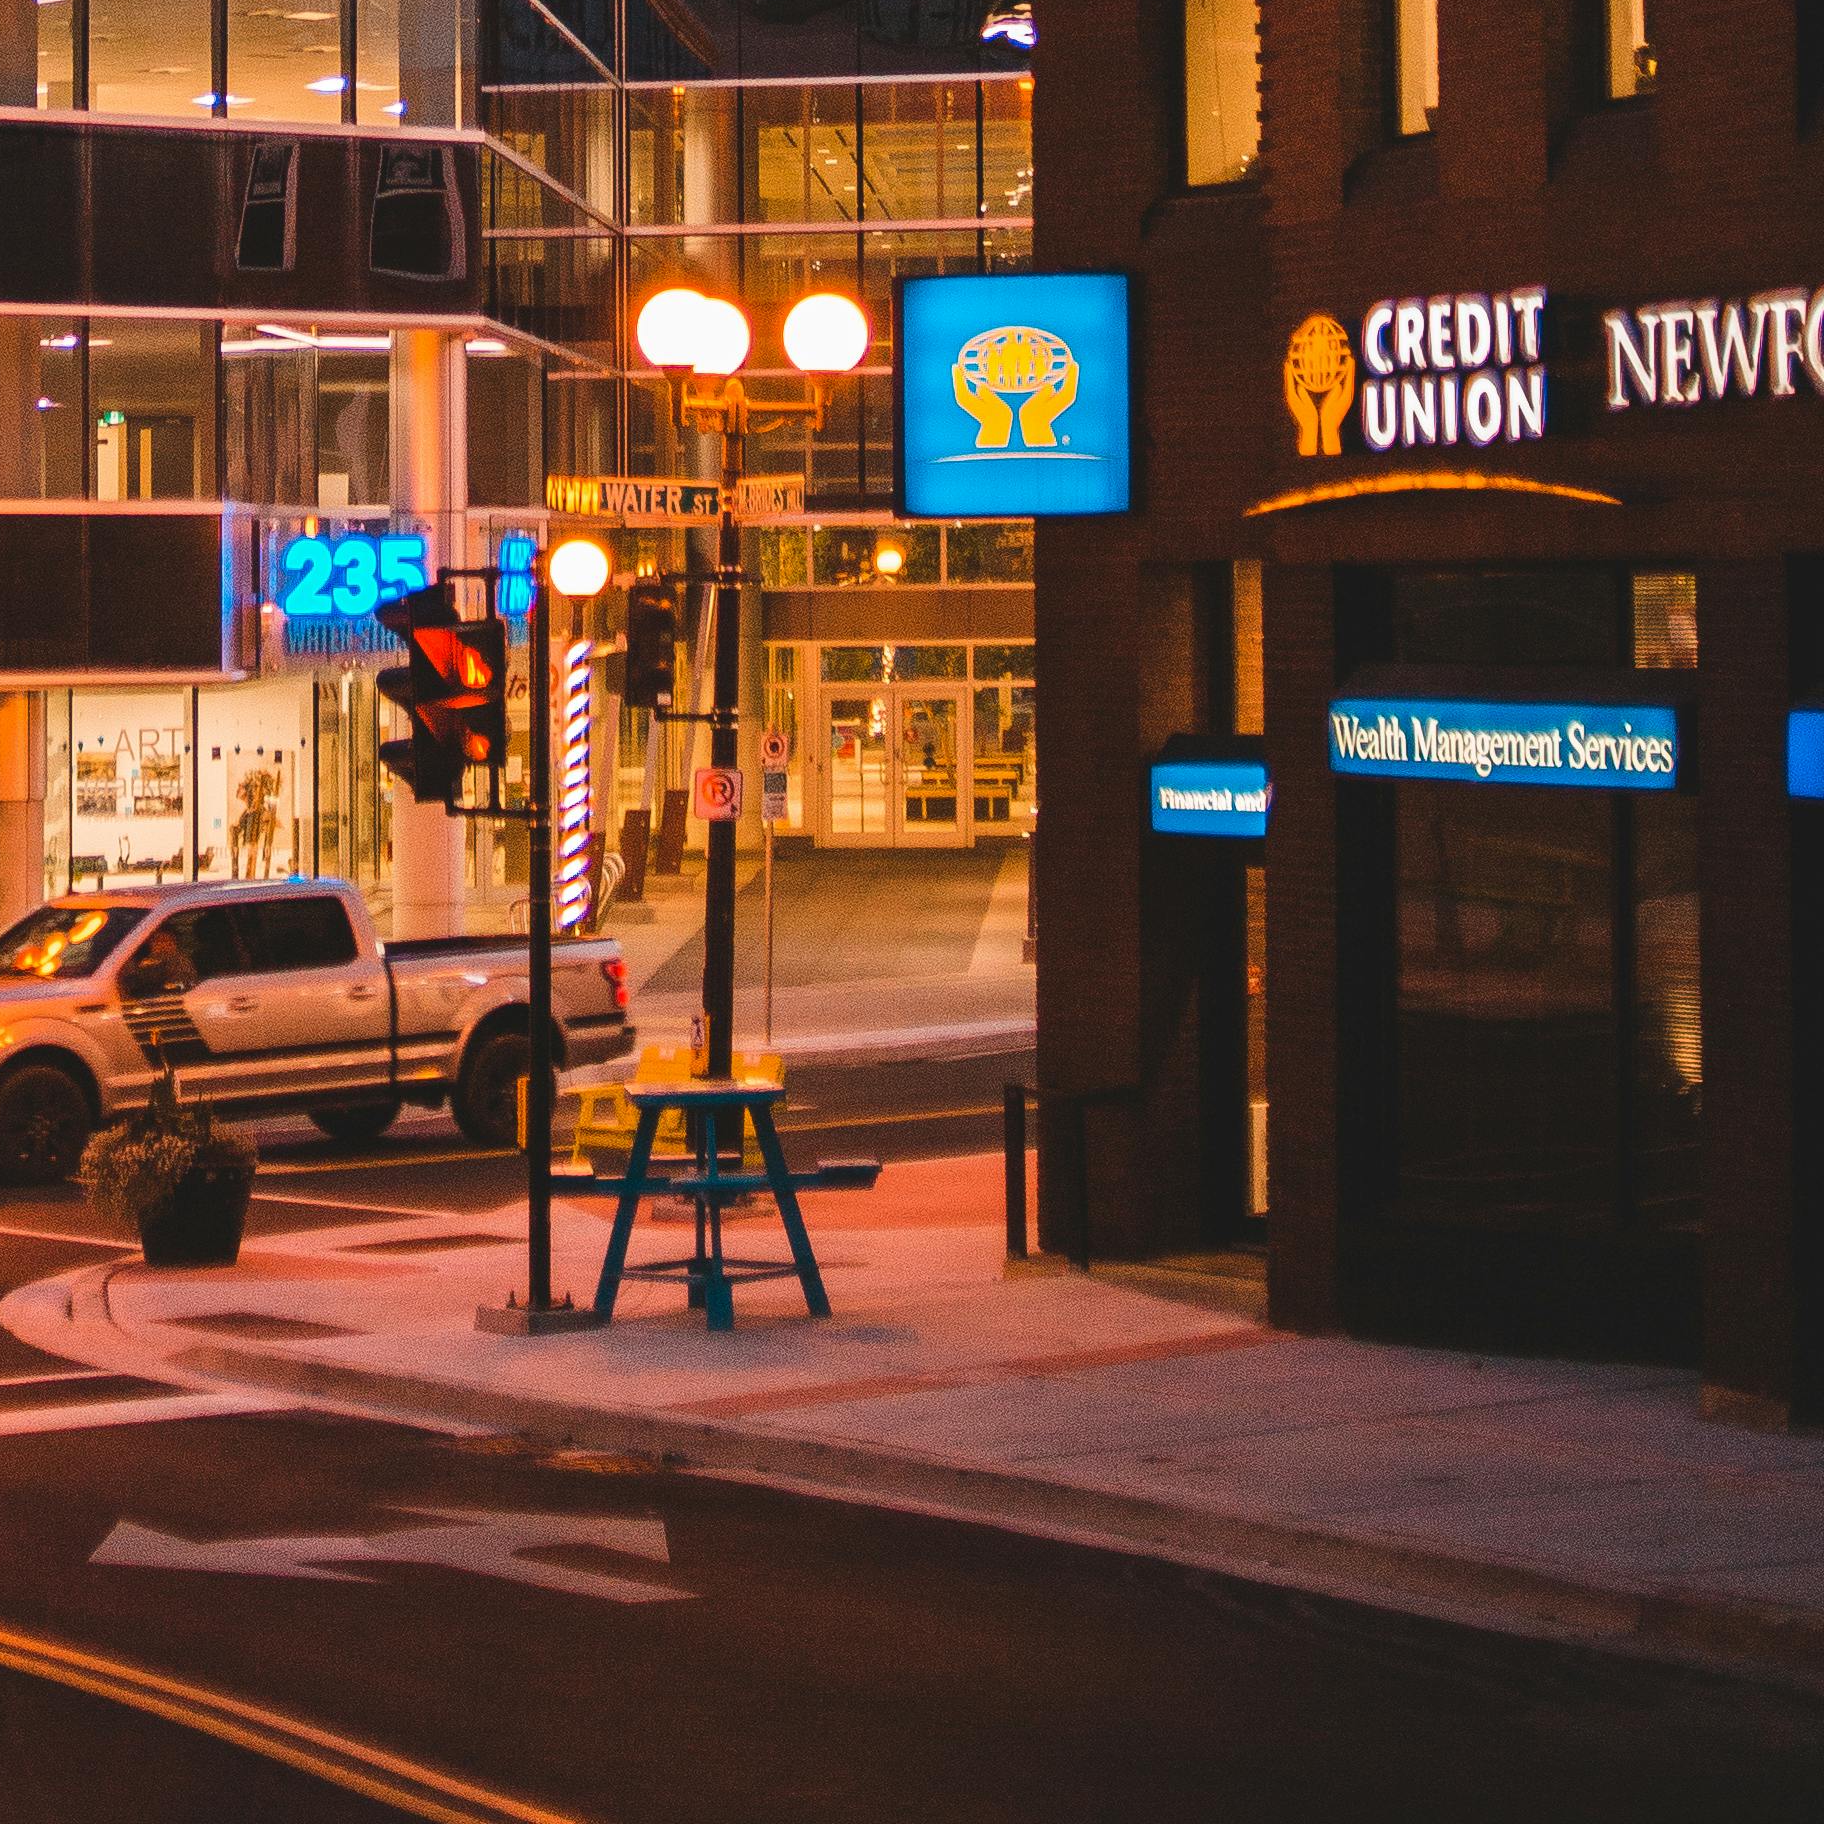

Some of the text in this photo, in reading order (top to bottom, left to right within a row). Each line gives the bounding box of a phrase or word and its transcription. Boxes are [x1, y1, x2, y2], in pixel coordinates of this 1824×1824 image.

[1364, 290, 1547, 374] CREDIT
[1364, 368, 1546, 448] UNION
[606, 483, 682, 516] WATER
[693, 496, 712, 516] ST
[285, 536, 425, 616] 235
[115, 728, 185, 762] ART
[1331, 713, 1674, 777] Wealth Management Services
[1159, 787, 1267, 812] Financial and
